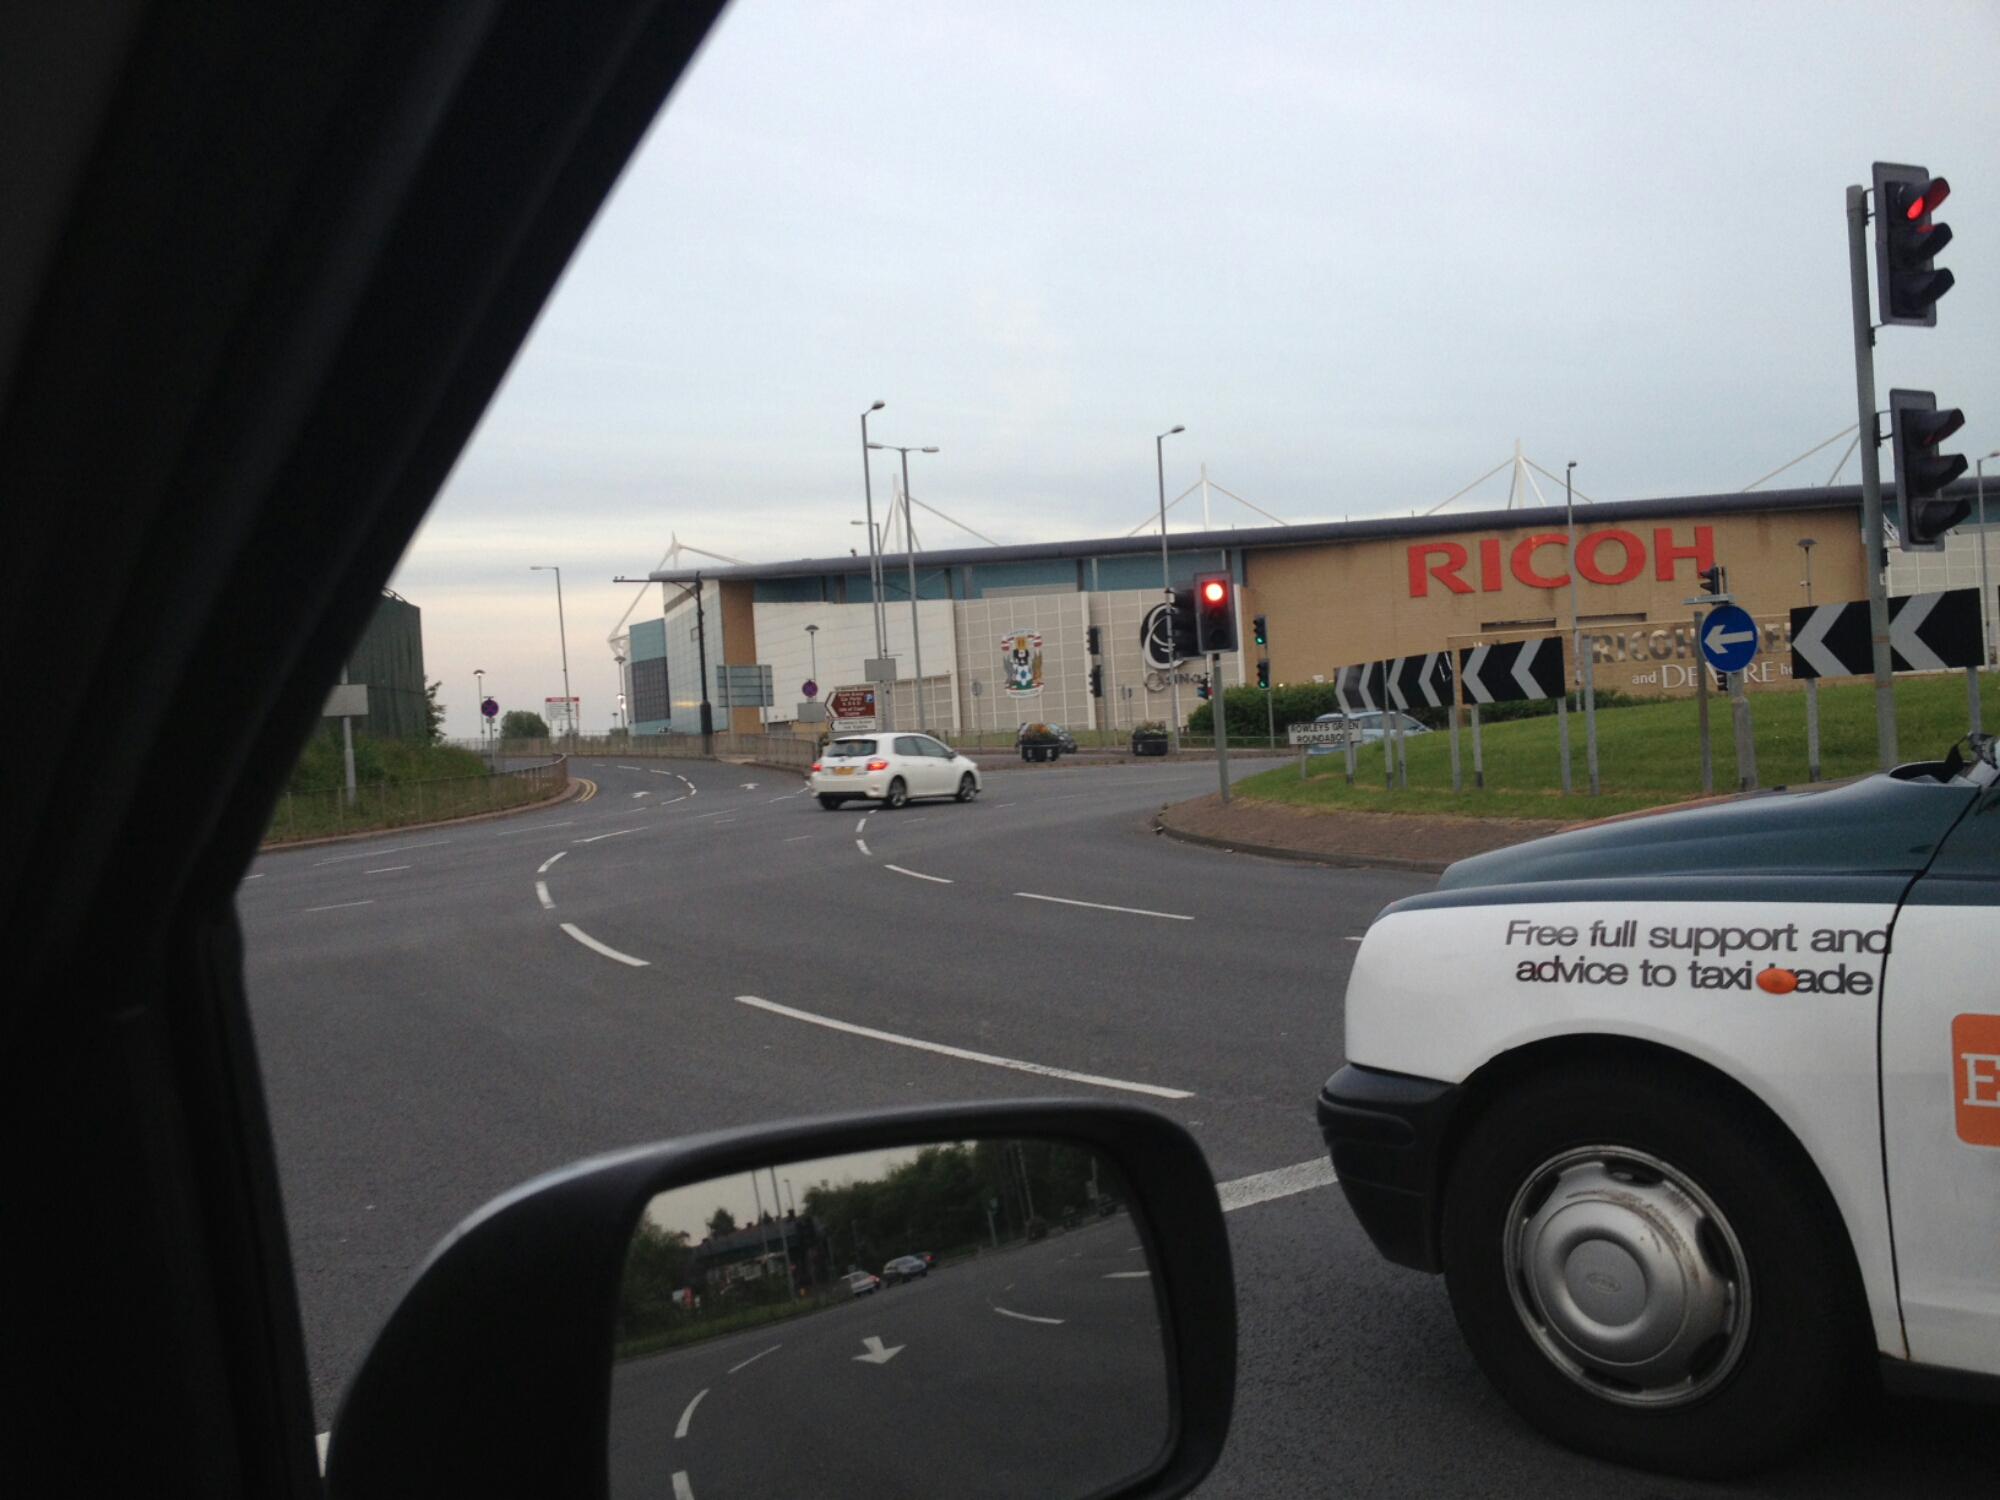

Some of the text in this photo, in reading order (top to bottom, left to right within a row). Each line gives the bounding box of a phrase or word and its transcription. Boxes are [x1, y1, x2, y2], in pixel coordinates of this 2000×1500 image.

[1407, 525, 1715, 598] RICOH
[1632, 671, 1657, 685] and
[1290, 720, 1359, 733] ROWLEYS GREN
[1506, 920, 1892, 957] Free full support and
[1516, 955, 1874, 996] advice to taxi ade
